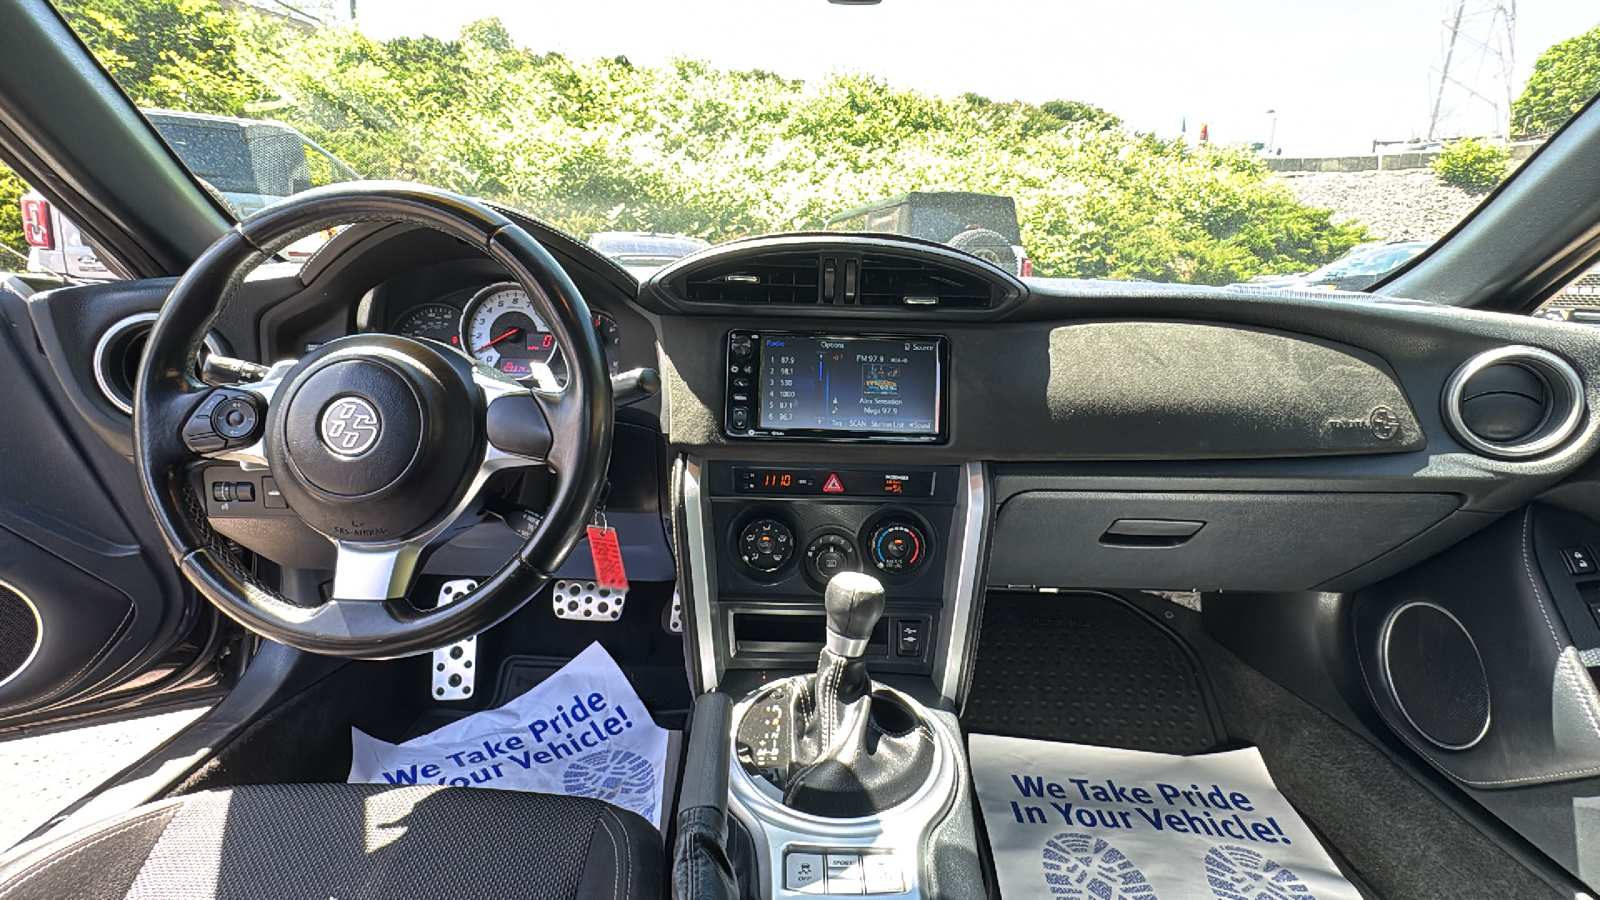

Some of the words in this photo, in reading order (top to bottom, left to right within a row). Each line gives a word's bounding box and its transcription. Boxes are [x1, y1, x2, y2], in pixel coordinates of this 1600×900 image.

[542, 334, 552, 347] 0
[766, 340, 785, 348] Radio
[820, 341, 845, 350] Options
[912, 343, 934, 352] Source
[868, 355, 884, 363] 97.9
[769, 401, 774, 409] 5
[859, 397, 873, 405] Alex
[874, 398, 903, 406] Sensation
[863, 407, 881, 415] Mega
[881, 407, 898, 415] 97.9
[780, 413, 793, 421] 96.7
[831, 420, 843, 428] Tag
[849, 420, 867, 428] SCAN
[913, 421, 931, 429] Sound
[382, 763, 442, 785] We
[445, 735, 526, 768] Take
[528, 692, 608, 743] Pride
[507, 704, 634, 770] Vehicle!
[1011, 774, 1066, 799] We
[1068, 778, 1151, 804] Take
[1156, 783, 1255, 812] Pride
[1010, 801, 1048, 824] In
[1050, 802, 1131, 829] Your
[1136, 807, 1292, 845] Vehicle!
